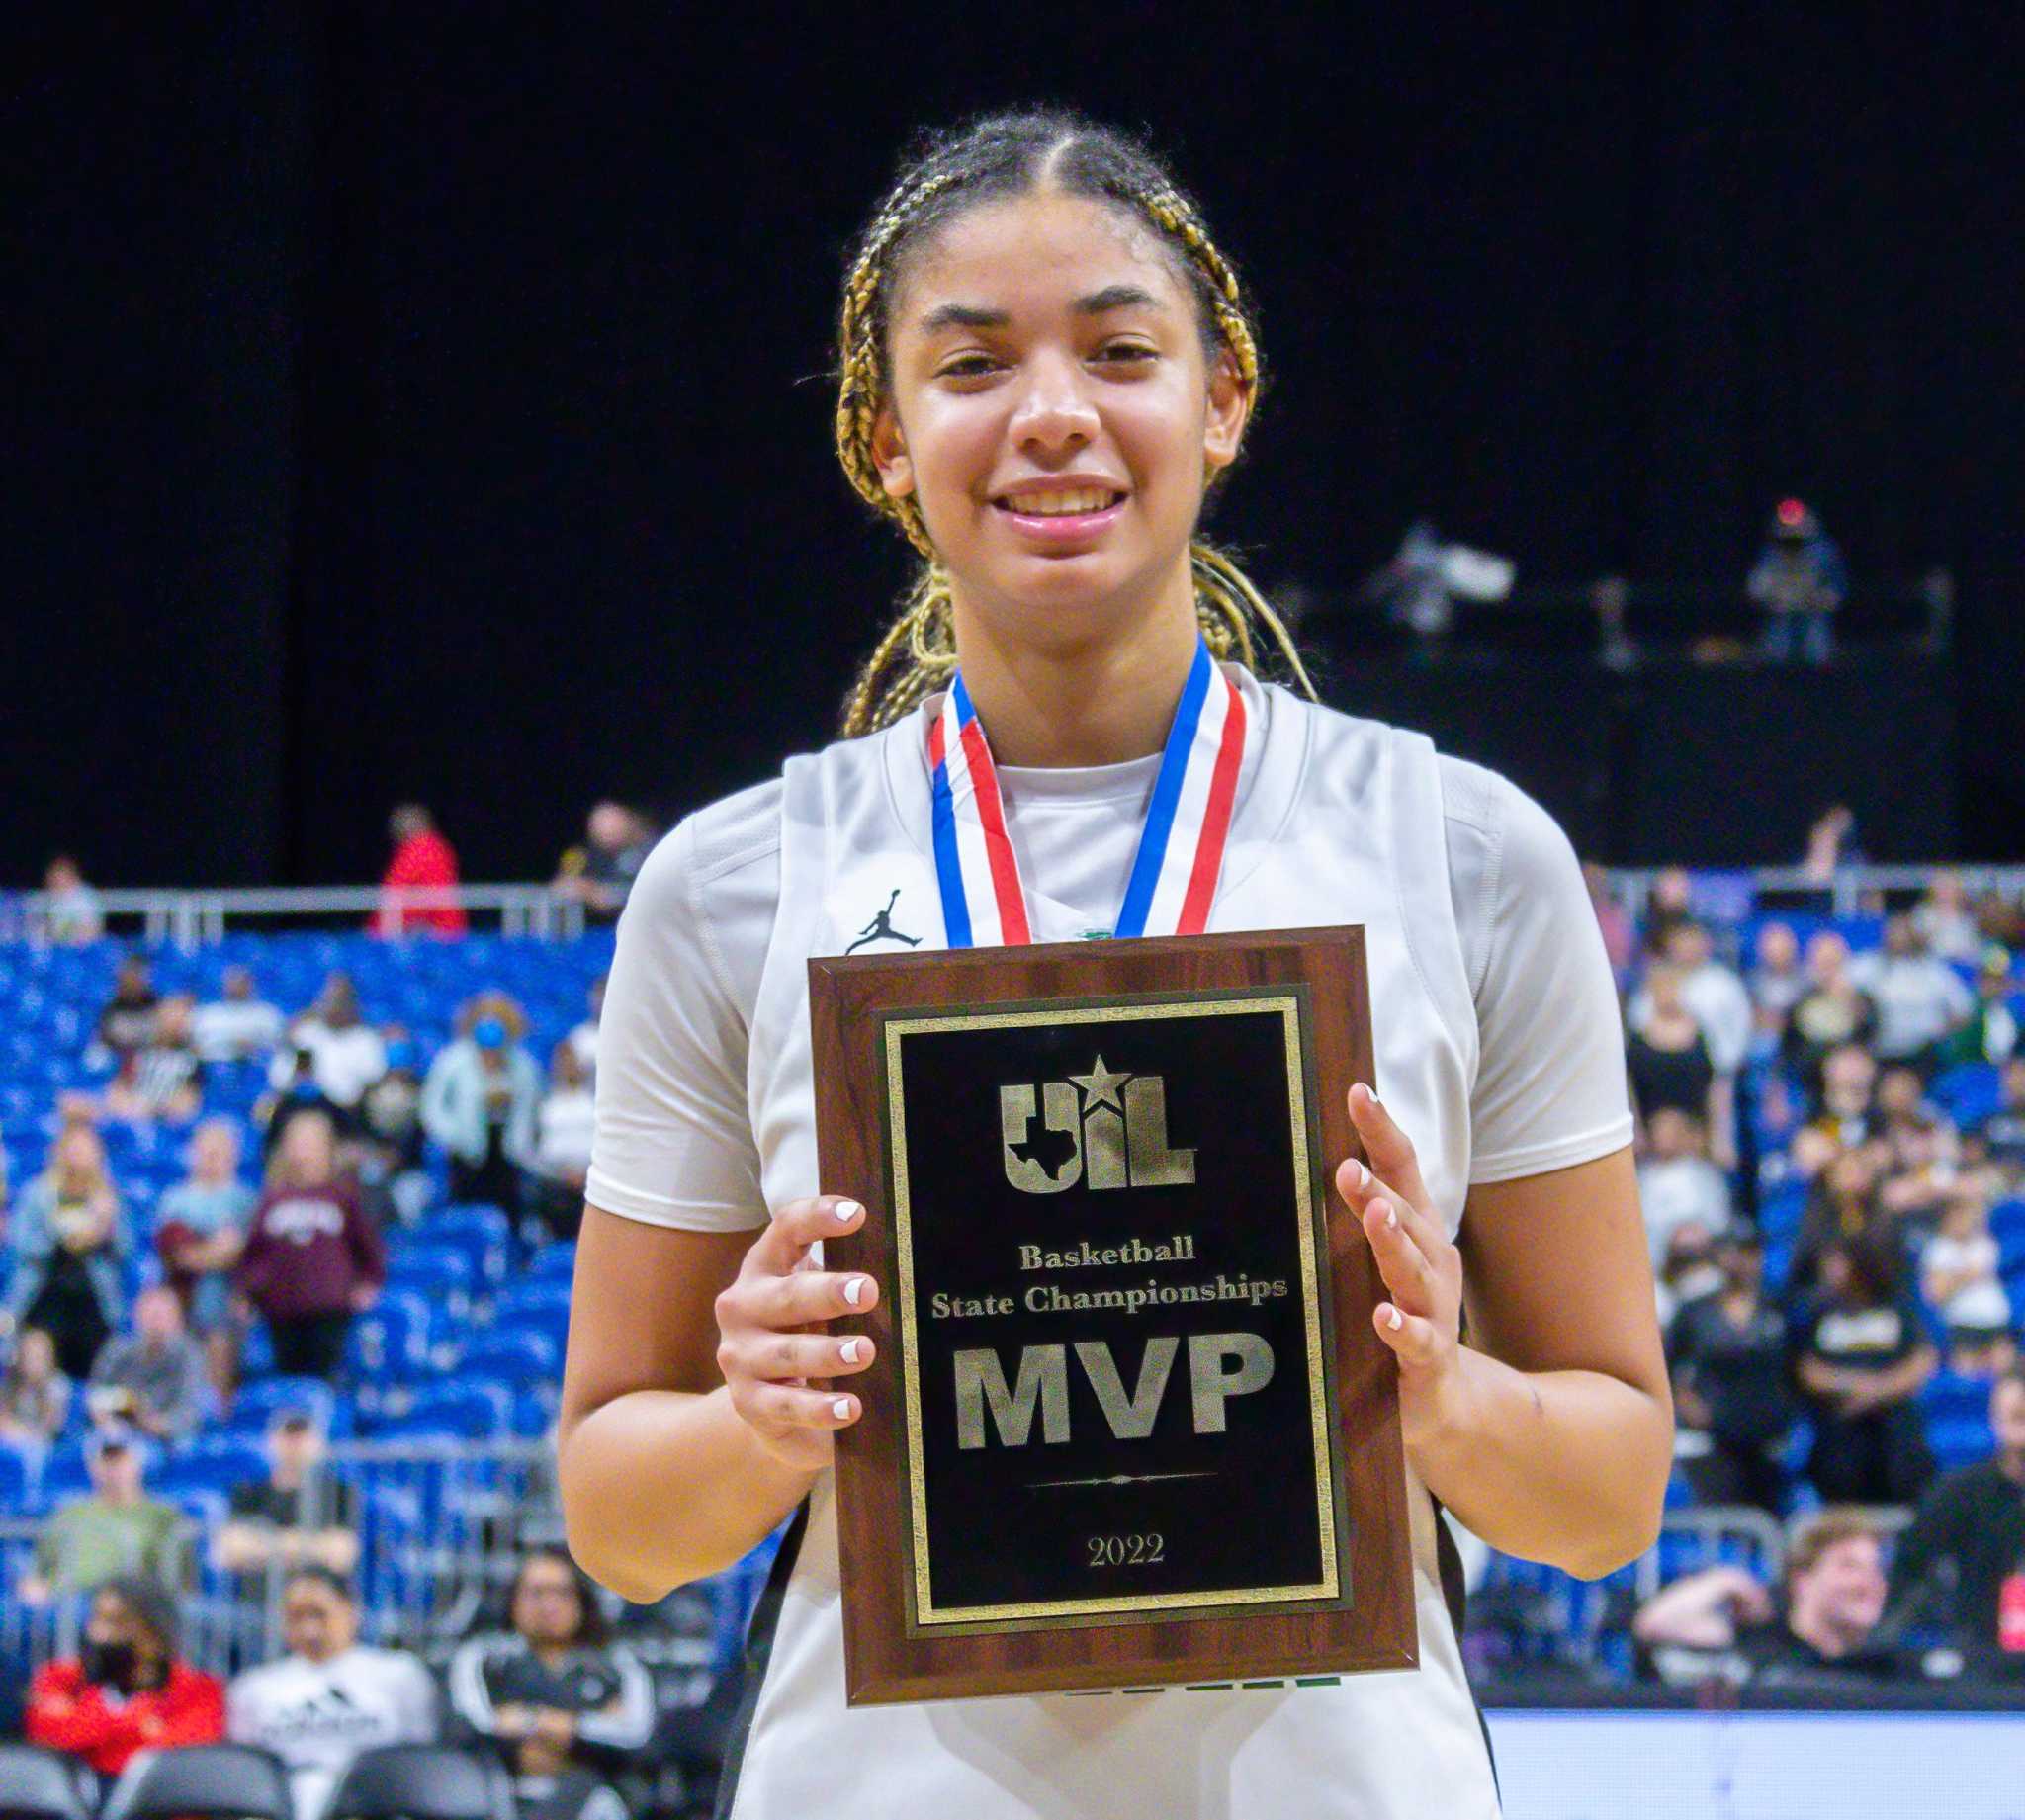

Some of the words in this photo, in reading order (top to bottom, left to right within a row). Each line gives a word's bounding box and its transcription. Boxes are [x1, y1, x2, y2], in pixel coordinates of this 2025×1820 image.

[1000, 1055, 1197, 1193] UIL
[1019, 1236, 1196, 1271] Basketball
[931, 1294, 1016, 1319] State
[1024, 1275, 1289, 1315] Championships
[953, 1333, 1276, 1450] MVP
[1088, 1533, 1165, 1567] 2022
